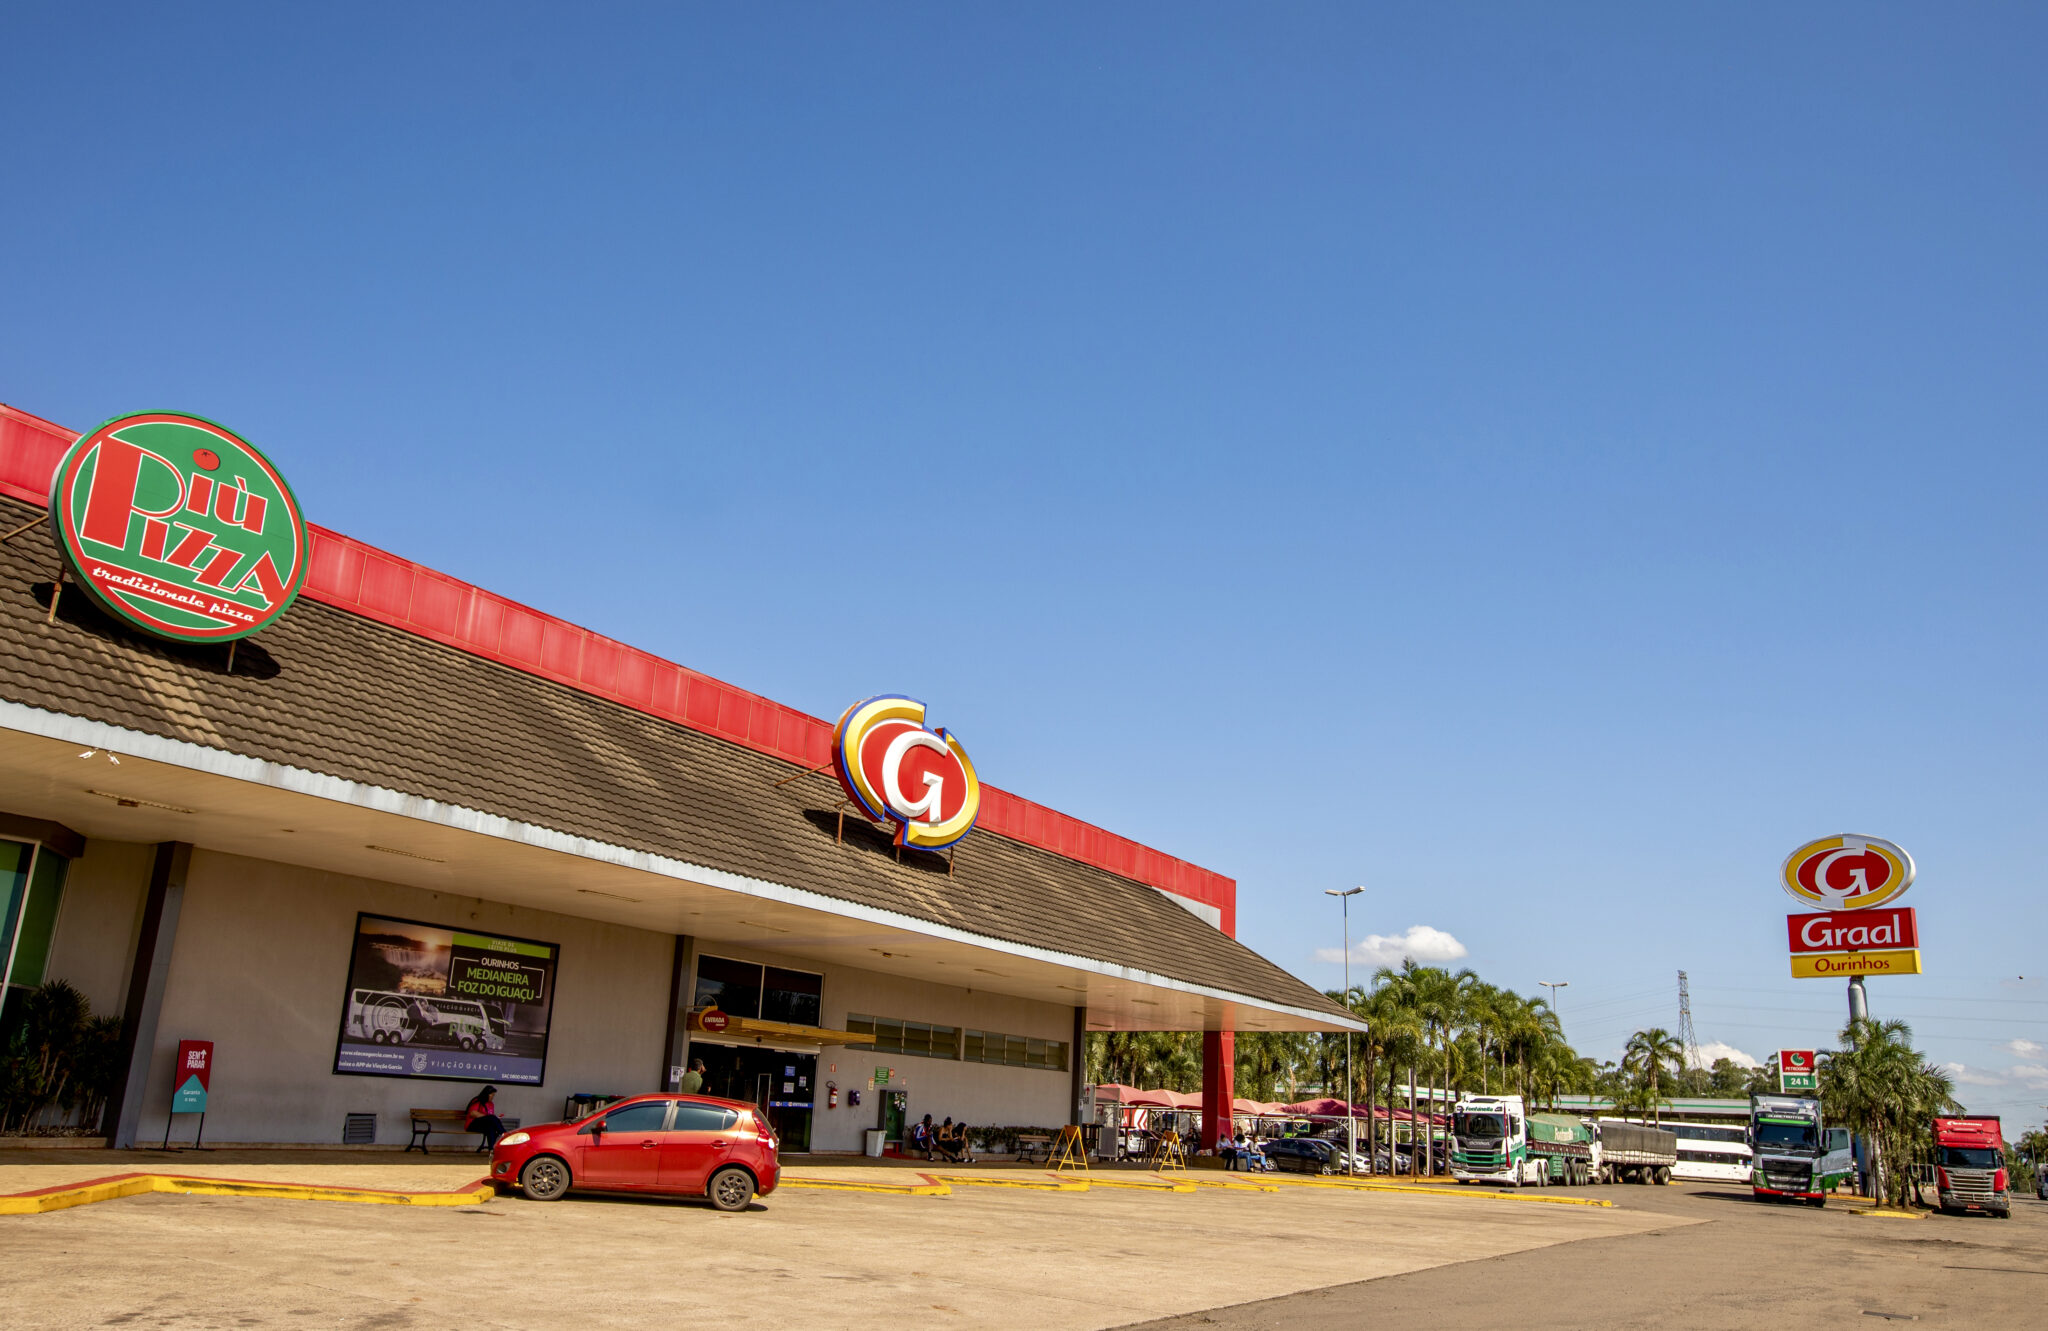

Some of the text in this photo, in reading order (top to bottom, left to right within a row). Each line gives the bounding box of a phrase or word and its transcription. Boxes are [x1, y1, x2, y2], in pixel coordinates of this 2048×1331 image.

[92, 566, 255, 623] tradizionale pizza
[1801, 914, 1901, 948] Graal
[481, 957, 519, 970] OURINHOS
[1814, 956, 1890, 972] Ourinhos
[466, 967, 529, 986] MEDIANEIRA
[457, 980, 535, 1003] FOZ DO IGUAÇU
[448, 1018, 483, 1037] plus
[431, 1060, 497, 1071] VIAÇÃO GARCIA
[1791, 1078, 1809, 1086] 24 h
